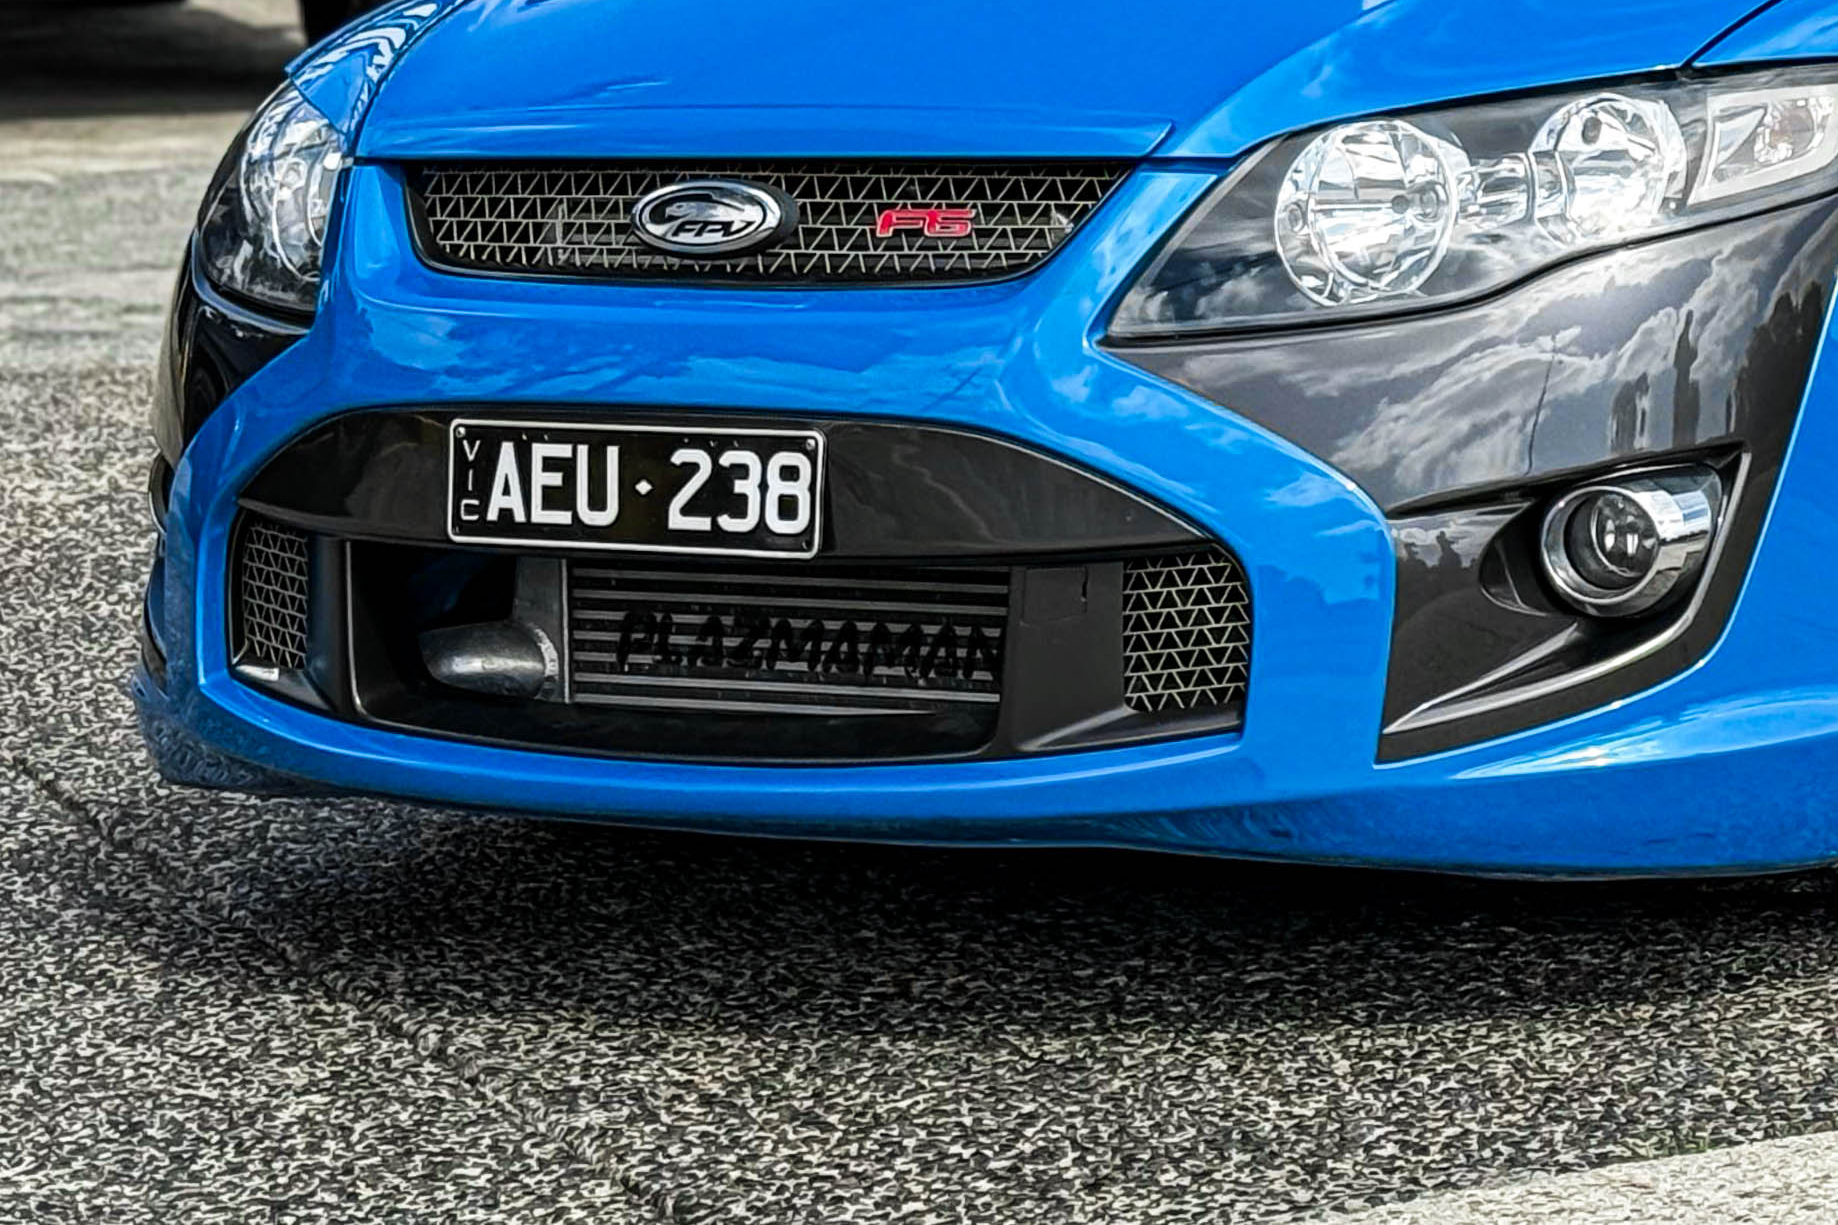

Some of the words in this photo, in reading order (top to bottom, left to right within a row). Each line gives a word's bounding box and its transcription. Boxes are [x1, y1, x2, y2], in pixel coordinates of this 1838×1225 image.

[671, 220, 756, 237] FPV
[876, 208, 976, 237] F6
[486, 441, 620, 526] AEU
[668, 448, 812, 534] 238
